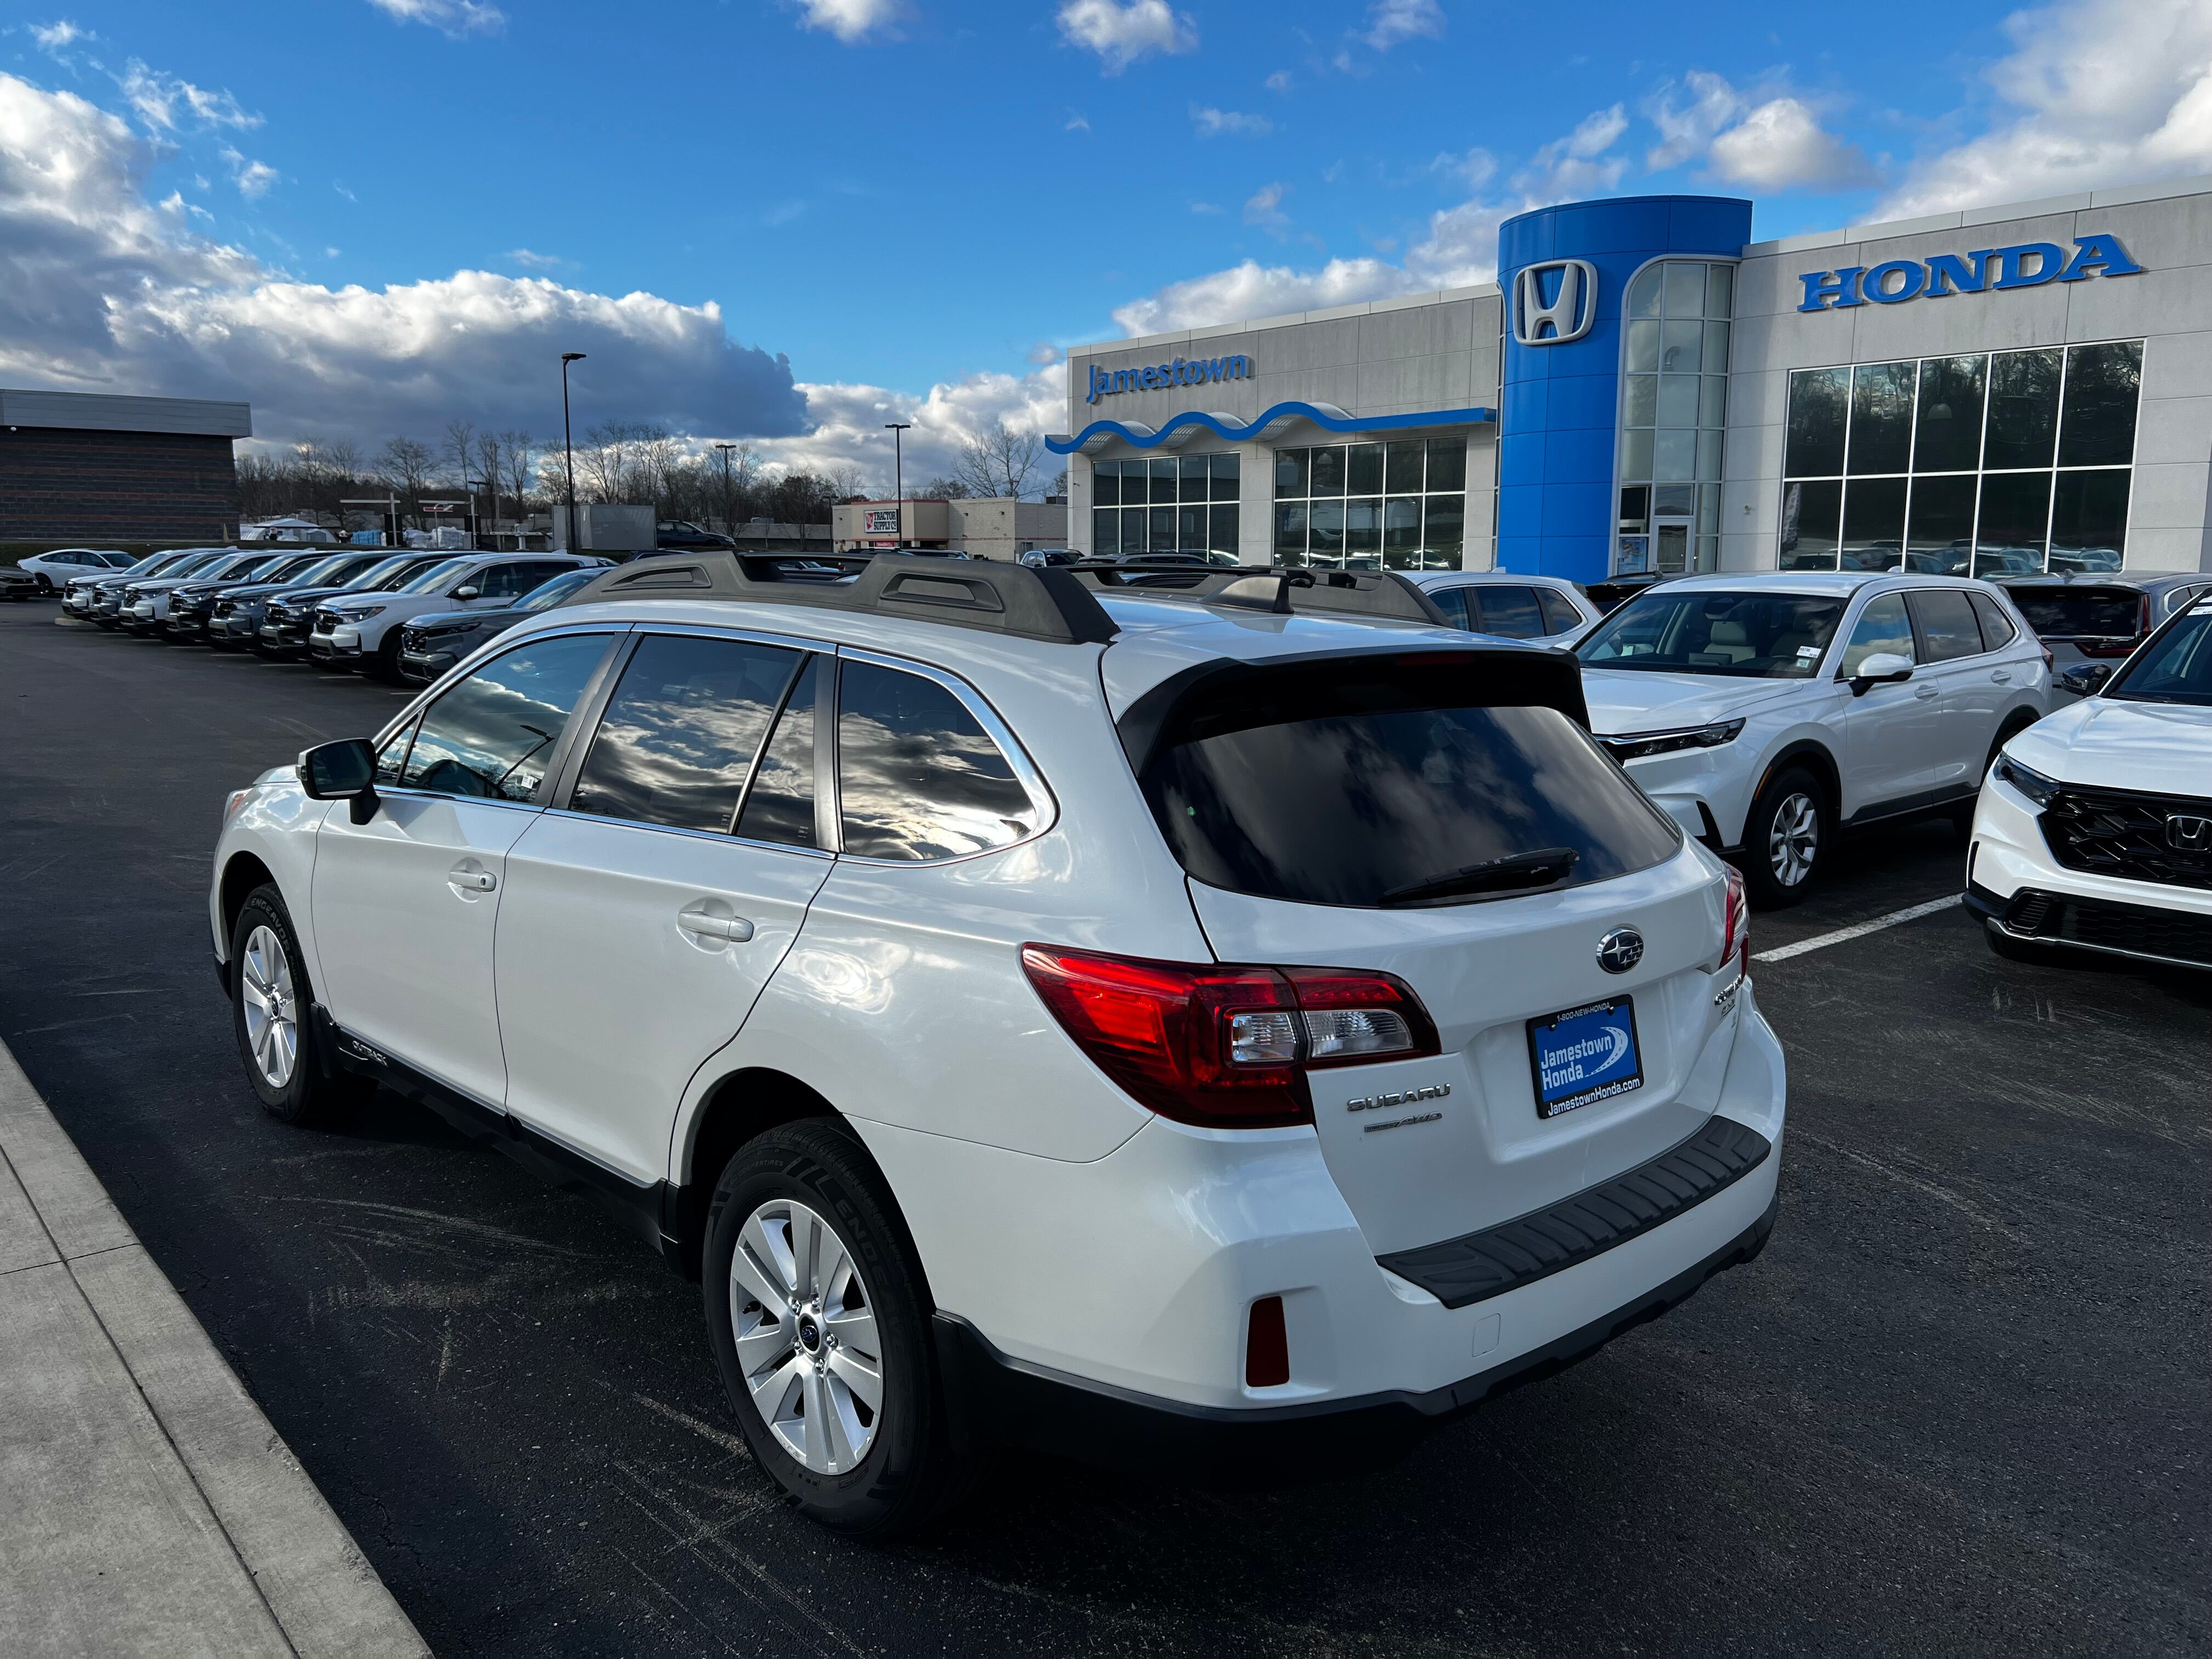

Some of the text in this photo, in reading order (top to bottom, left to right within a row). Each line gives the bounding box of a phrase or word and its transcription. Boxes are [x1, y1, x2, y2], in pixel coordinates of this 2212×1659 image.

[1797, 234, 2140, 312] HONDA
[1086, 354, 1250, 404] Jamestown
[873, 511, 896, 521] TRACTOR
[873, 521, 890, 531] SUPPLY
[251, 897, 291, 952] ENDEAVOR
[1556, 1002, 1611, 1022] 1-800-NEW-HONDA
[1541, 1035, 1612, 1070] Jamestown
[1542, 1061, 1584, 1091] Honda
[1347, 1082, 1451, 1112] SUBARU
[1548, 1077, 1641, 1116] JamestownHonda.com
